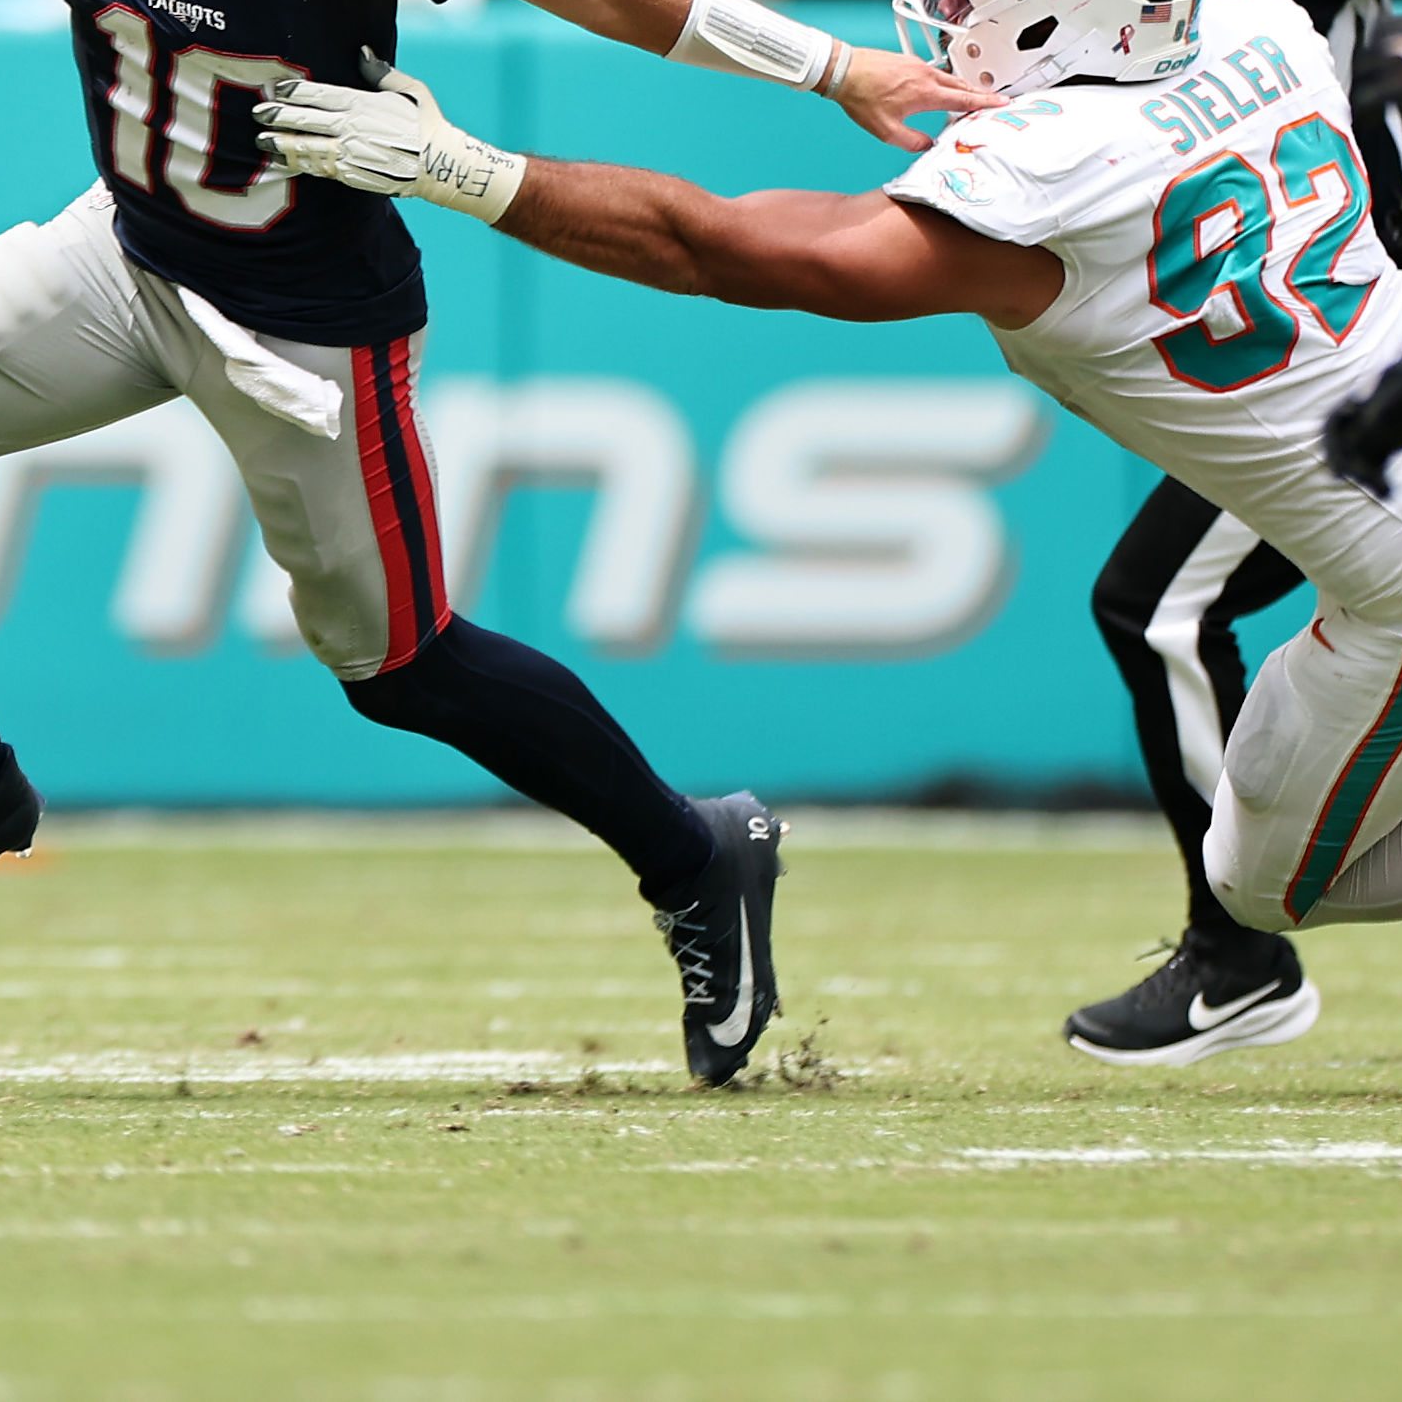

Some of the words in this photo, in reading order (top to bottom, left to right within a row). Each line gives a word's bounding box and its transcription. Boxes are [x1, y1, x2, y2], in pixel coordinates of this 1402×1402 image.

[93, 2, 312, 232] 10
[1139, 35, 1302, 156] SIELER
[421, 141, 496, 198] EARN
[1147, 110, 1372, 394] 92
[748, 816, 770, 841] 10
